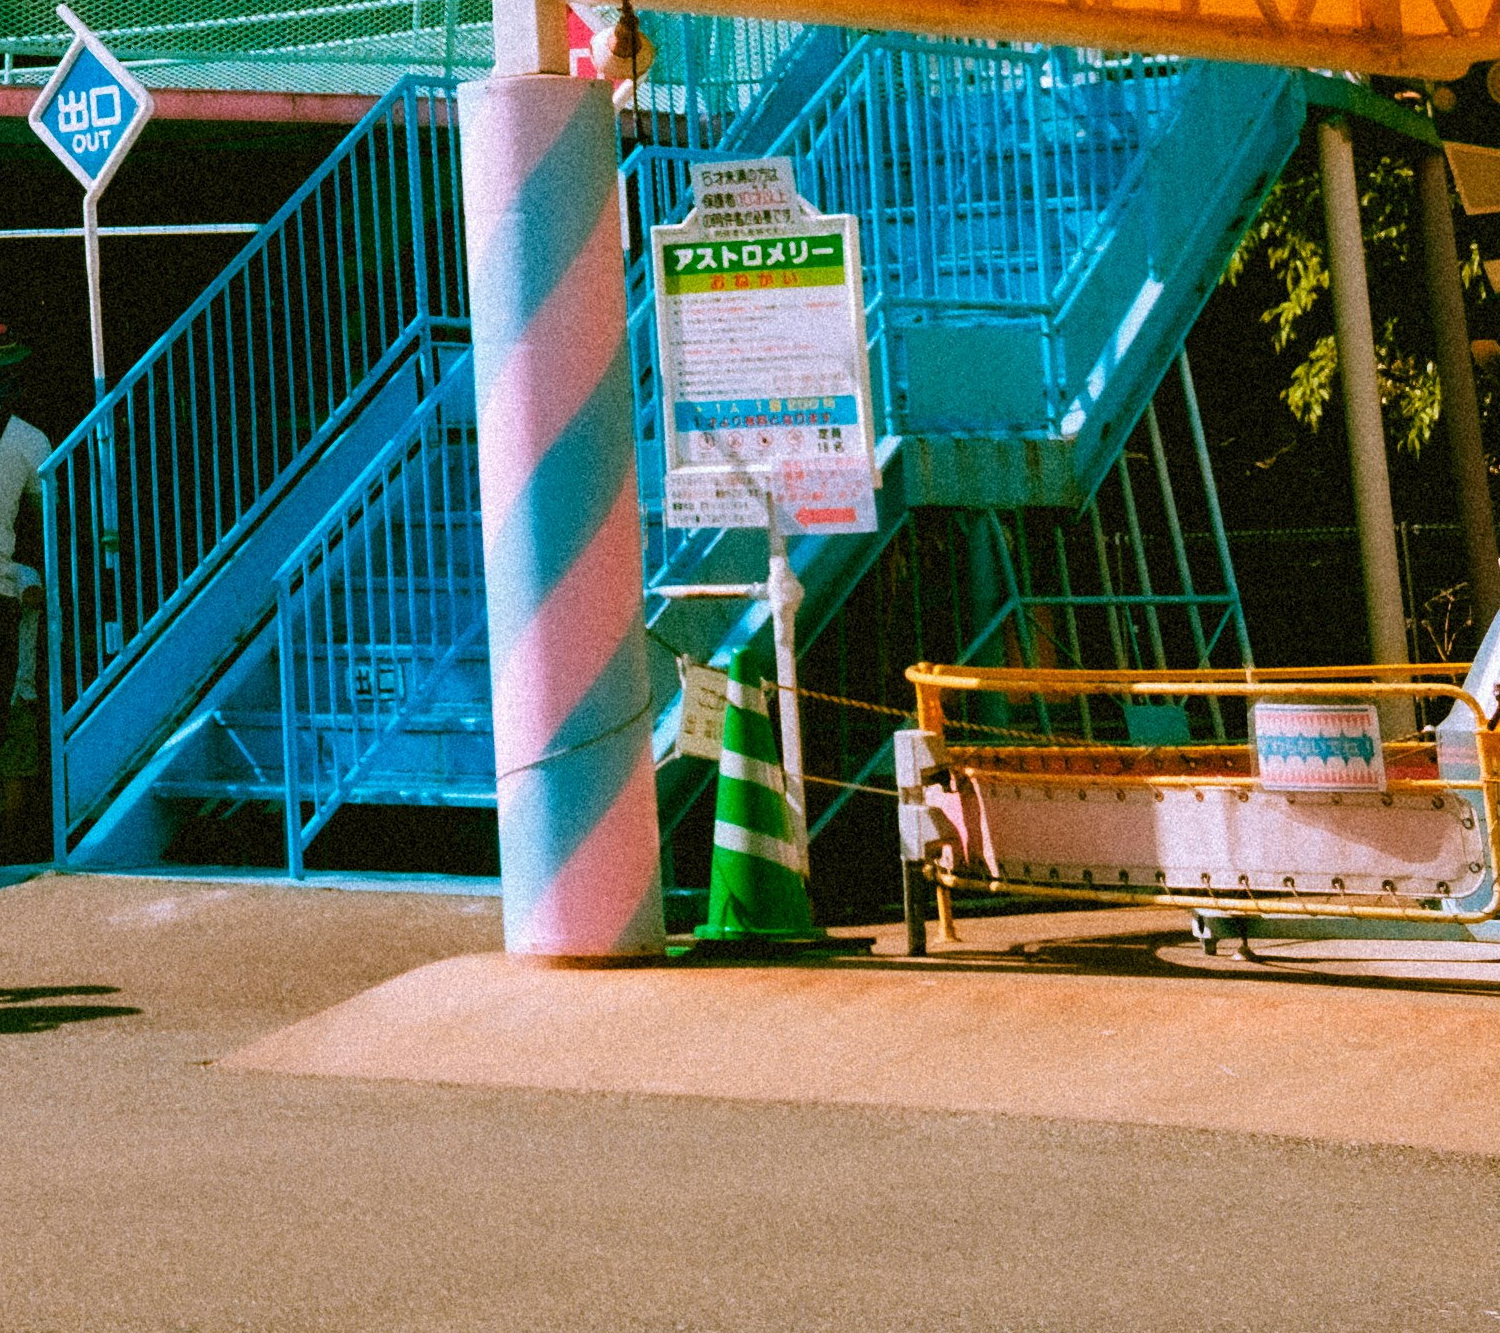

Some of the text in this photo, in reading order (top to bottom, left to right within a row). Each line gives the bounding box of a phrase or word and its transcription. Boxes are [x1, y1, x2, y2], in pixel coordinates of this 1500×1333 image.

[57, 84, 122, 133] 出口
[71, 129, 112, 154] OUT
[672, 239, 834, 271] アストロメリー
[710, 271, 800, 291] おねがい
